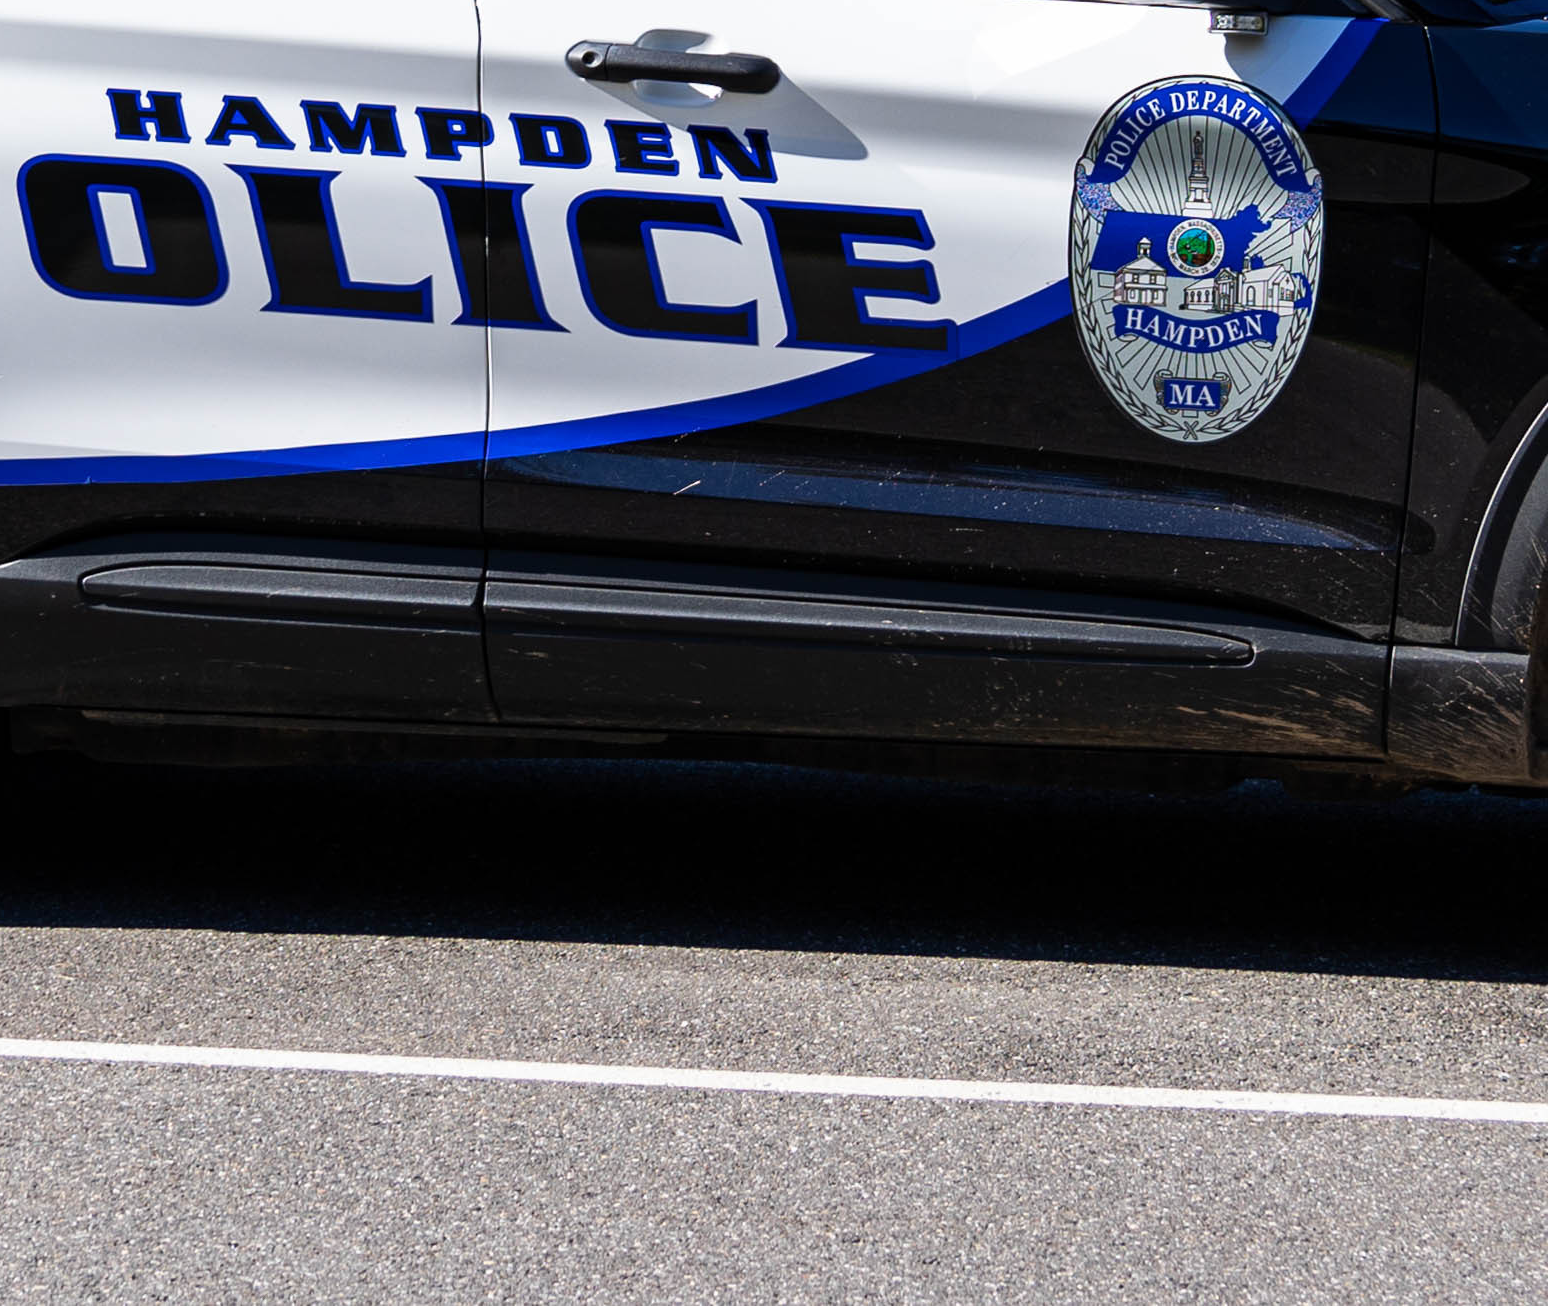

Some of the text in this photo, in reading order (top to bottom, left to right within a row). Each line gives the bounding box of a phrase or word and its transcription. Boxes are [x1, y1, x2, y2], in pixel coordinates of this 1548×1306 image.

[104, 88, 780, 185] HAMPDEN
[1104, 89, 1298, 178] POLICE DEPARTMENT
[1123, 306, 1265, 349] HAMPDEN
[1168, 383, 1217, 408] MA
